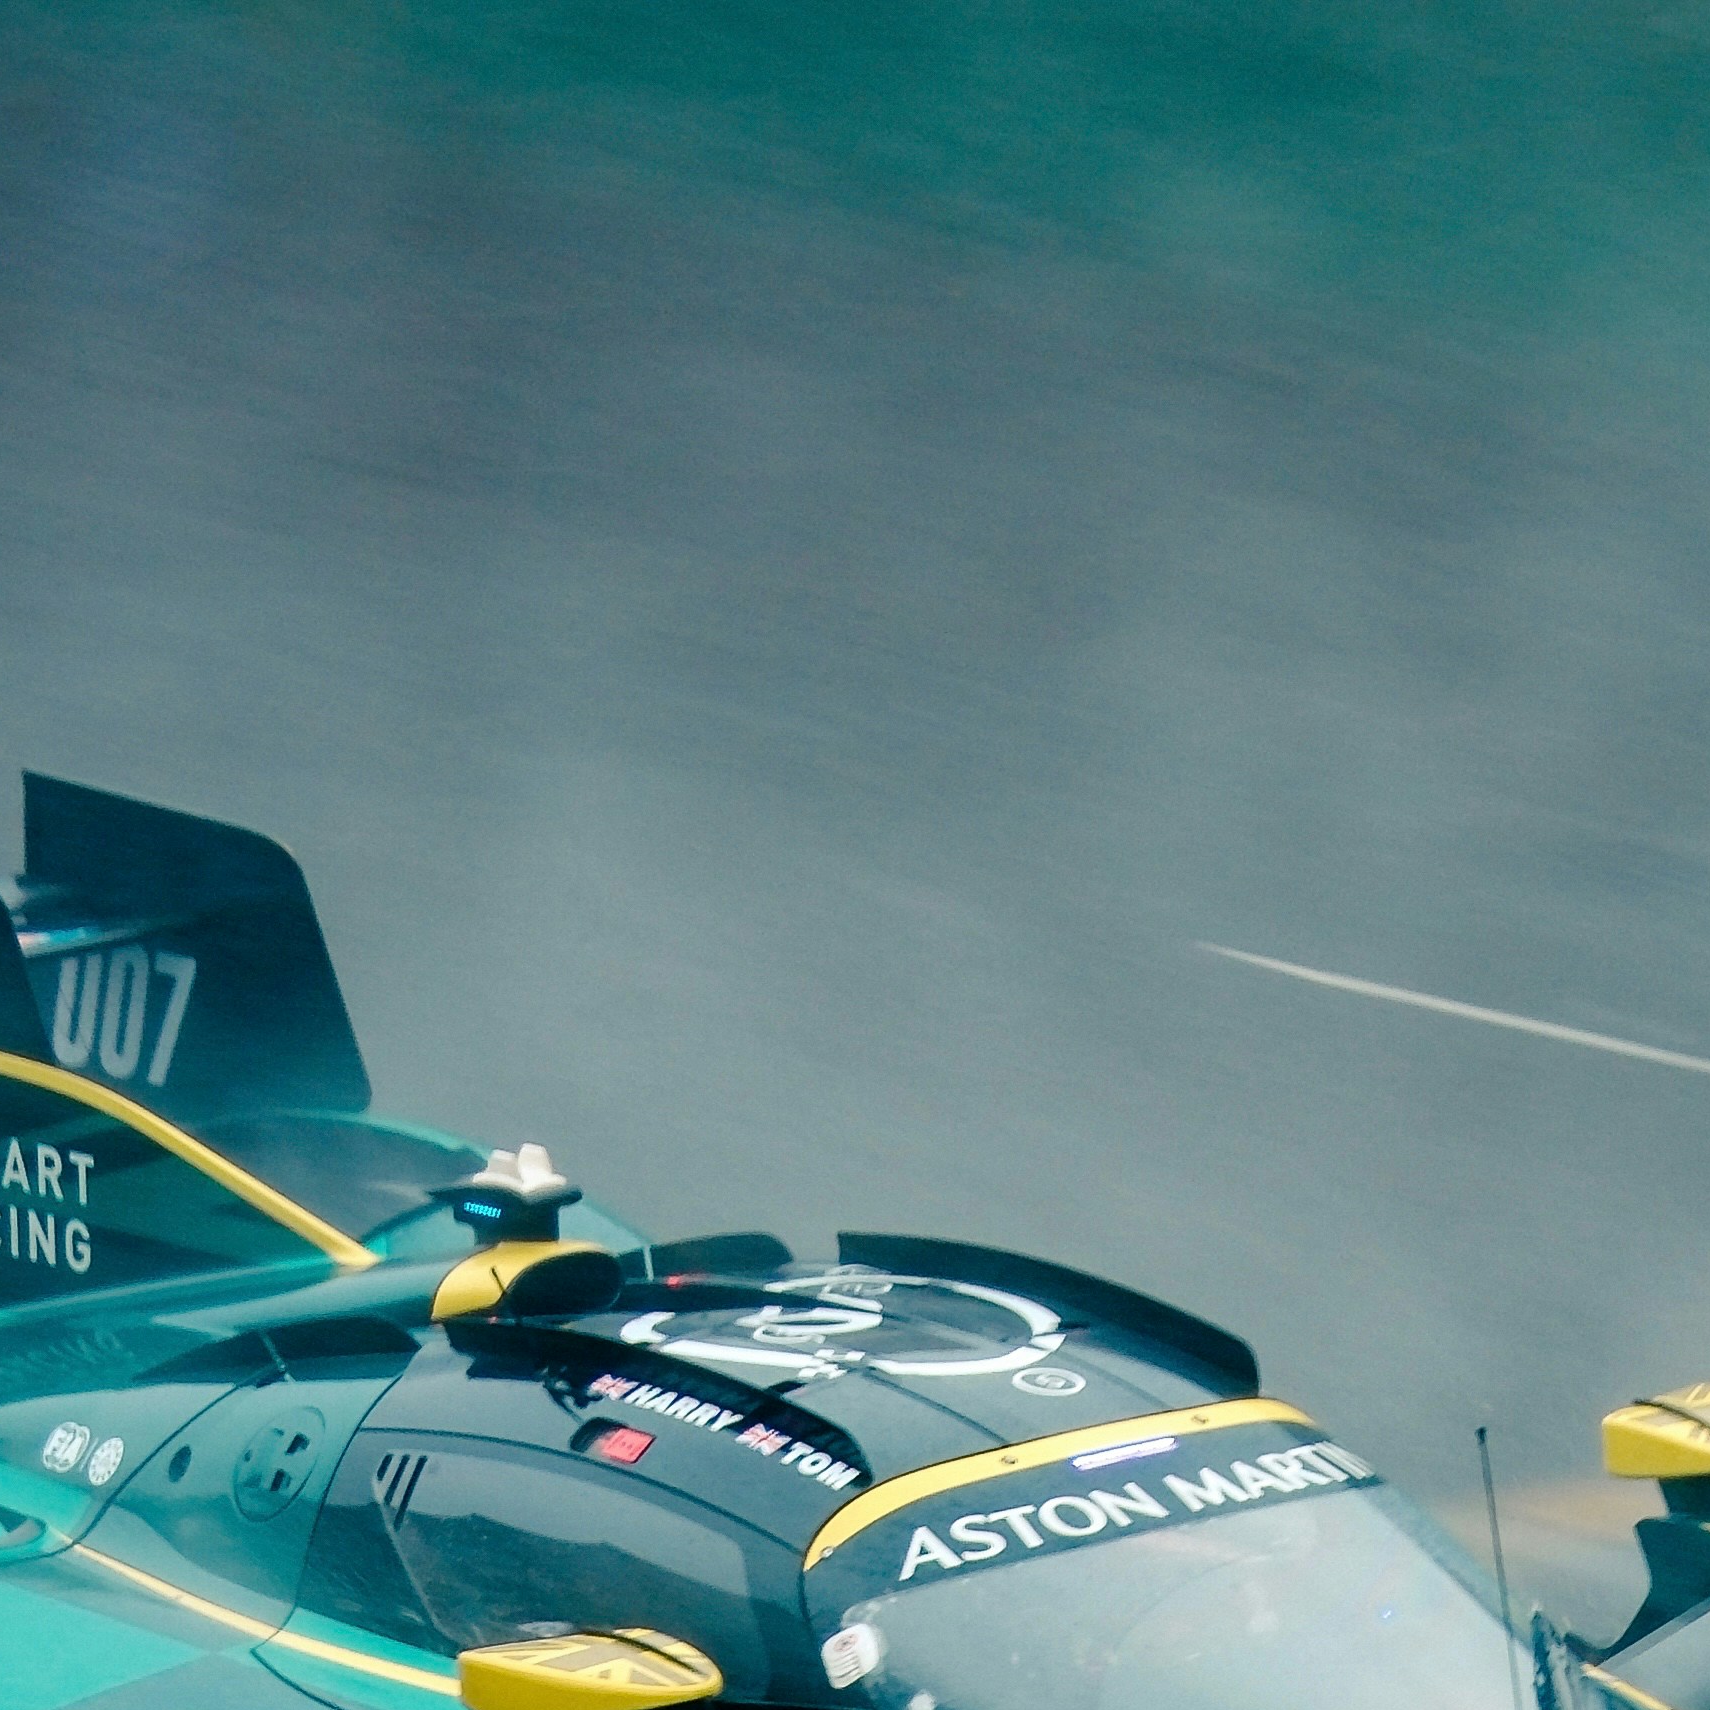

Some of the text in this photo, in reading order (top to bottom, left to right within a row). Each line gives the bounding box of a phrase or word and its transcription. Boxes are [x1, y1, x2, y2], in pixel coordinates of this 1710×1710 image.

[624, 1384, 862, 1491] HARRY TOM
[898, 1481, 1171, 1581] ASTON
